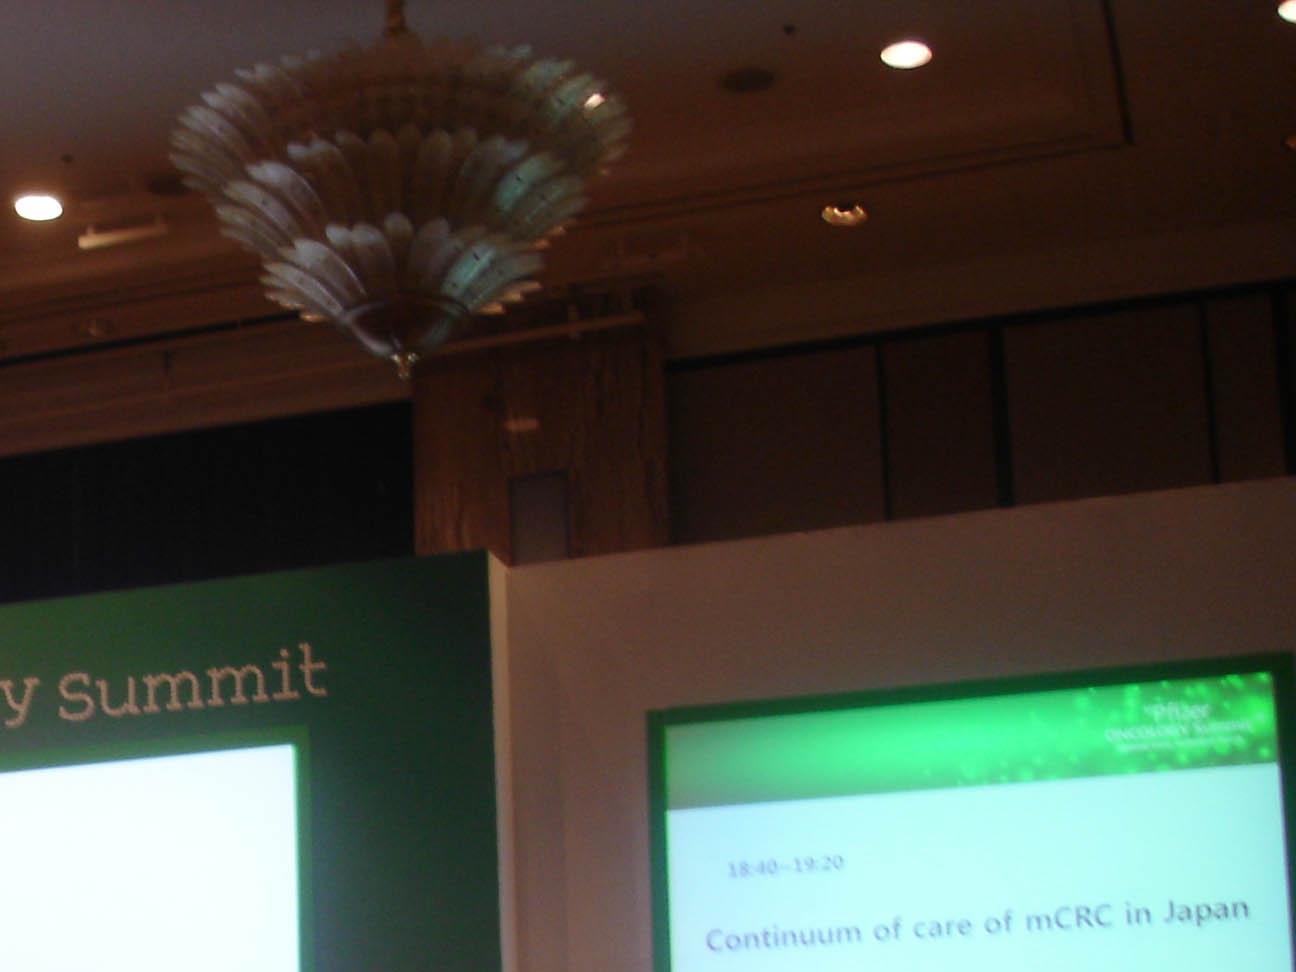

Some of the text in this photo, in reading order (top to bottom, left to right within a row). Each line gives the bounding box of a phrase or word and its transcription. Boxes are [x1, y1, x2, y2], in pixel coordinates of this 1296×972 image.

[57, 643, 328, 722] Summit
[706, 898, 1250, 953] Continuum of care of mCRC in Japan
